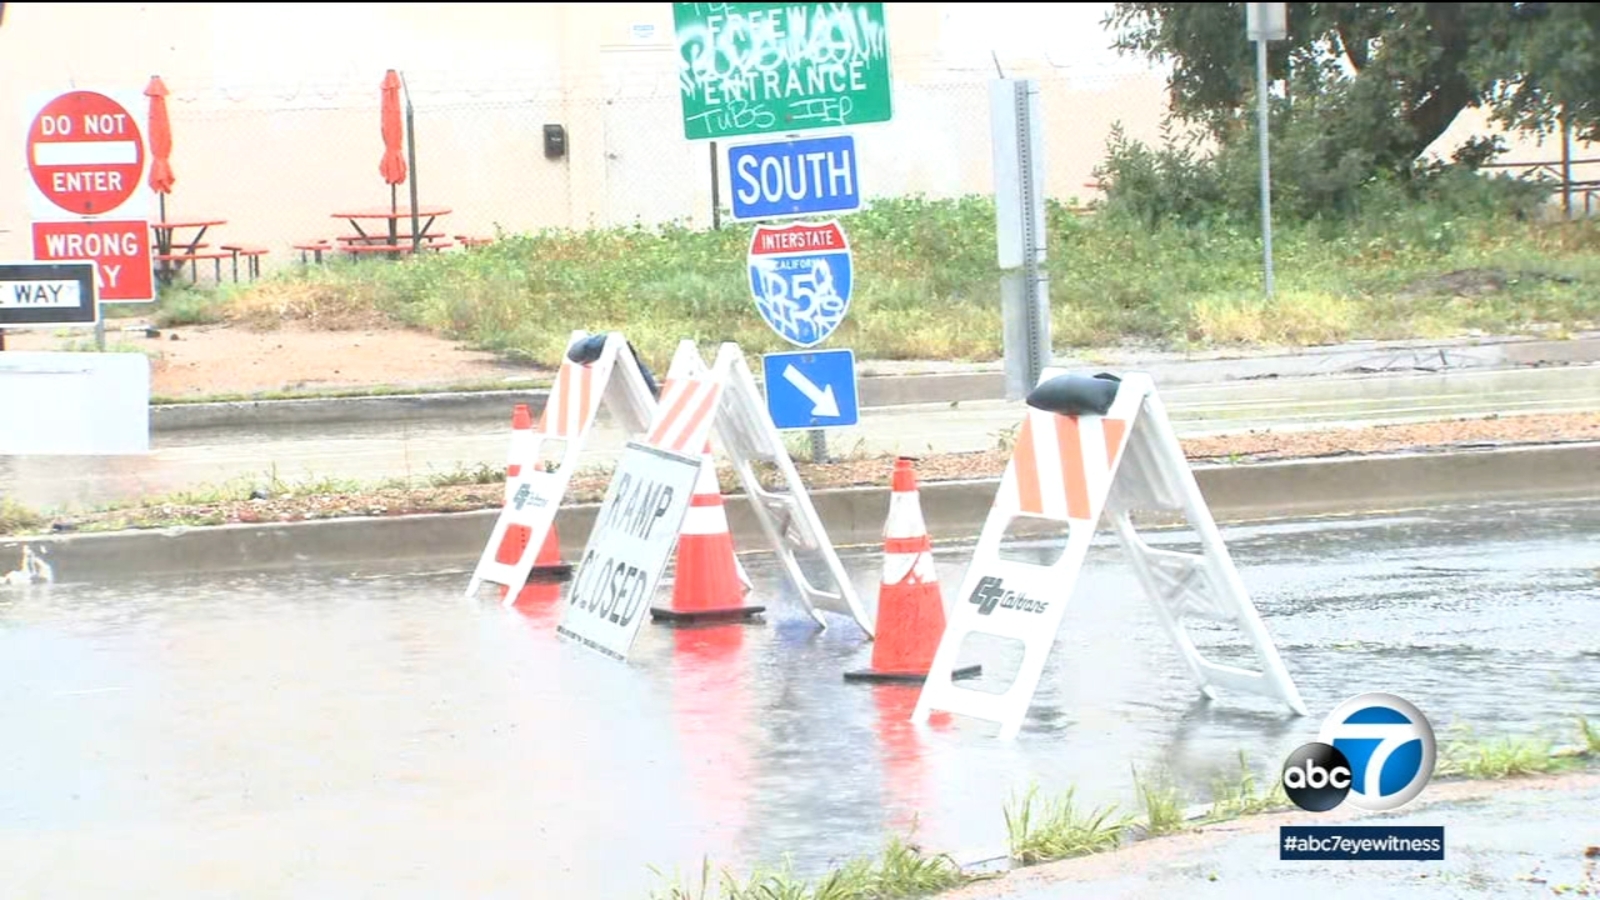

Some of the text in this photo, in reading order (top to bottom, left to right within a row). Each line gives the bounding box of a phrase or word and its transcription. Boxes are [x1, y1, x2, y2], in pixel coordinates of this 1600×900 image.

[704, 61, 867, 105] ENTRANCE
[41, 114, 126, 135] DO NOT
[53, 172, 122, 192] ENTER
[737, 150, 853, 204] SOUTH
[45, 233, 138, 257] WRONG
[761, 230, 834, 250] INTERSTATE
[14, 284, 63, 303] WAY
[603, 472, 674, 540] RAMP
[569, 549, 648, 627] CLOSED
